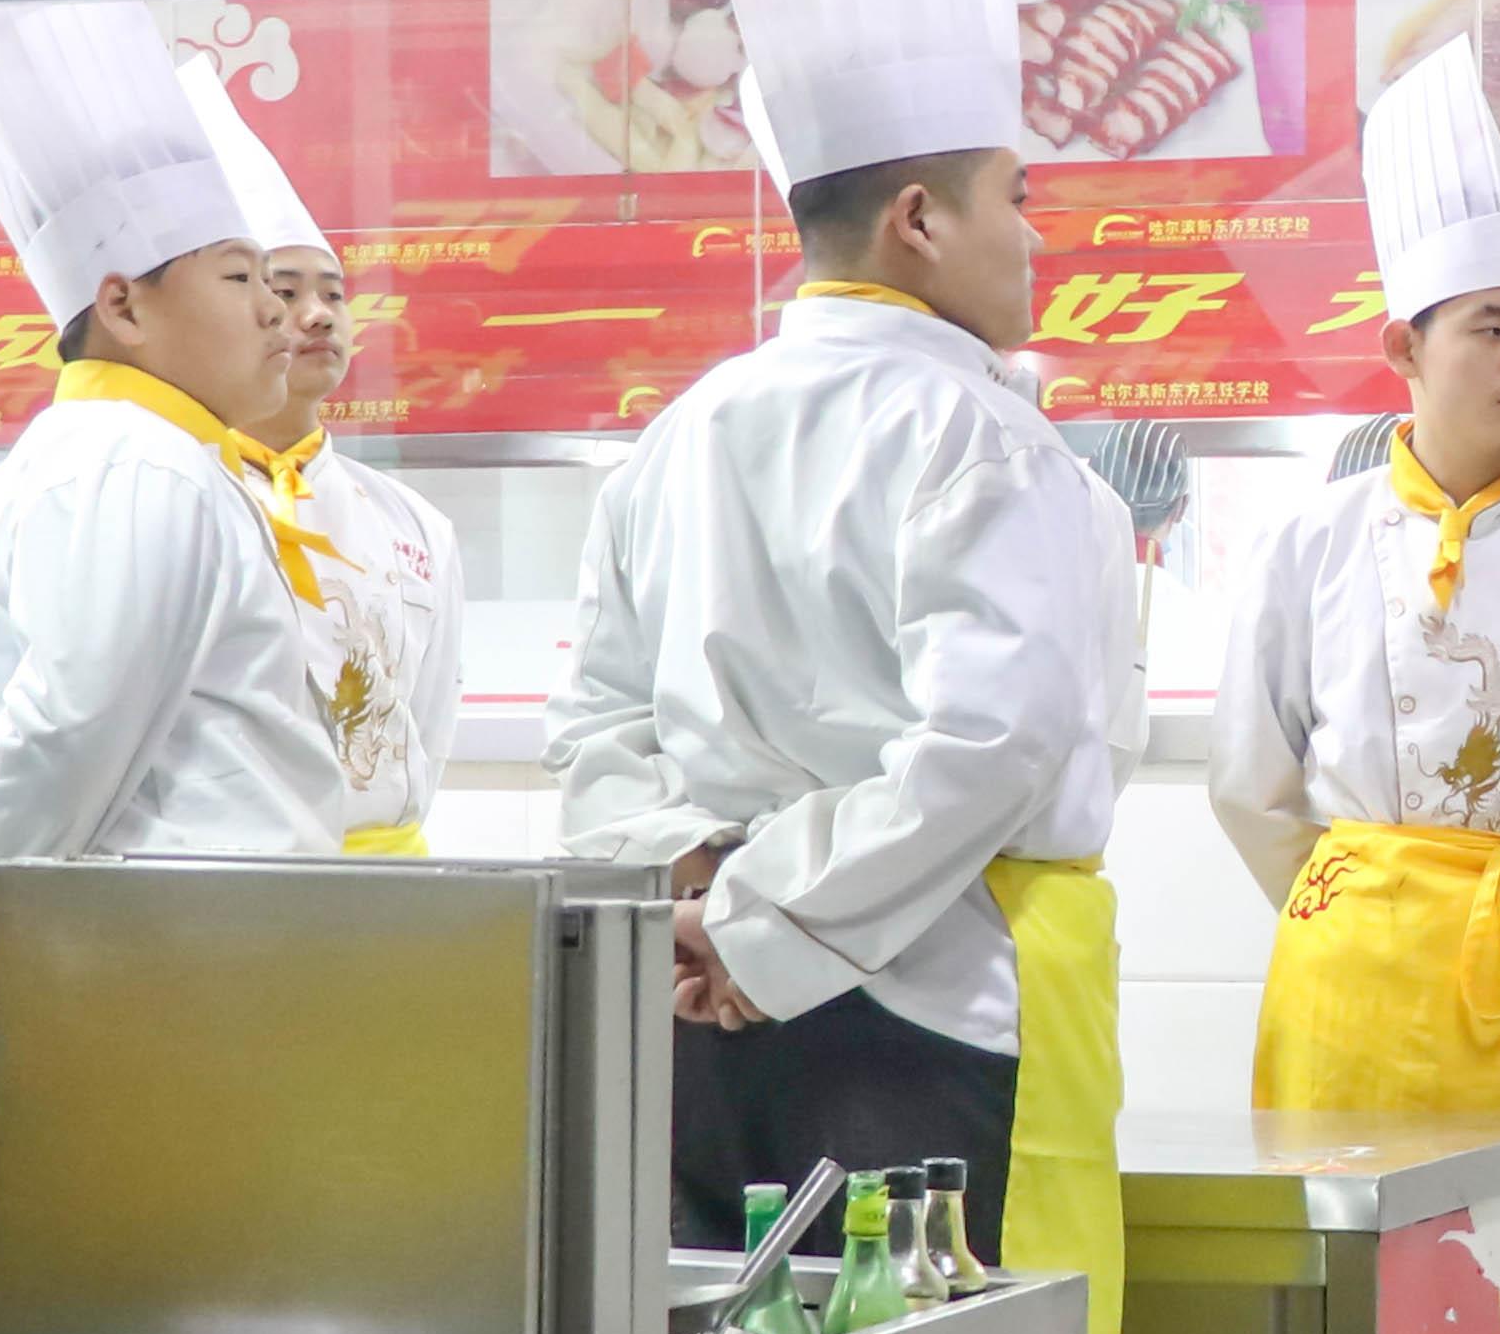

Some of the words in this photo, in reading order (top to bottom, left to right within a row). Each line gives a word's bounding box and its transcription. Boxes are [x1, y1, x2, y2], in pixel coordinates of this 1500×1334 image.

[1149, 217, 1310, 235] 哈尔滨新东方烹饪学校
[1100, 381, 1269, 400] 哈尔滨新东方烹饪学校
